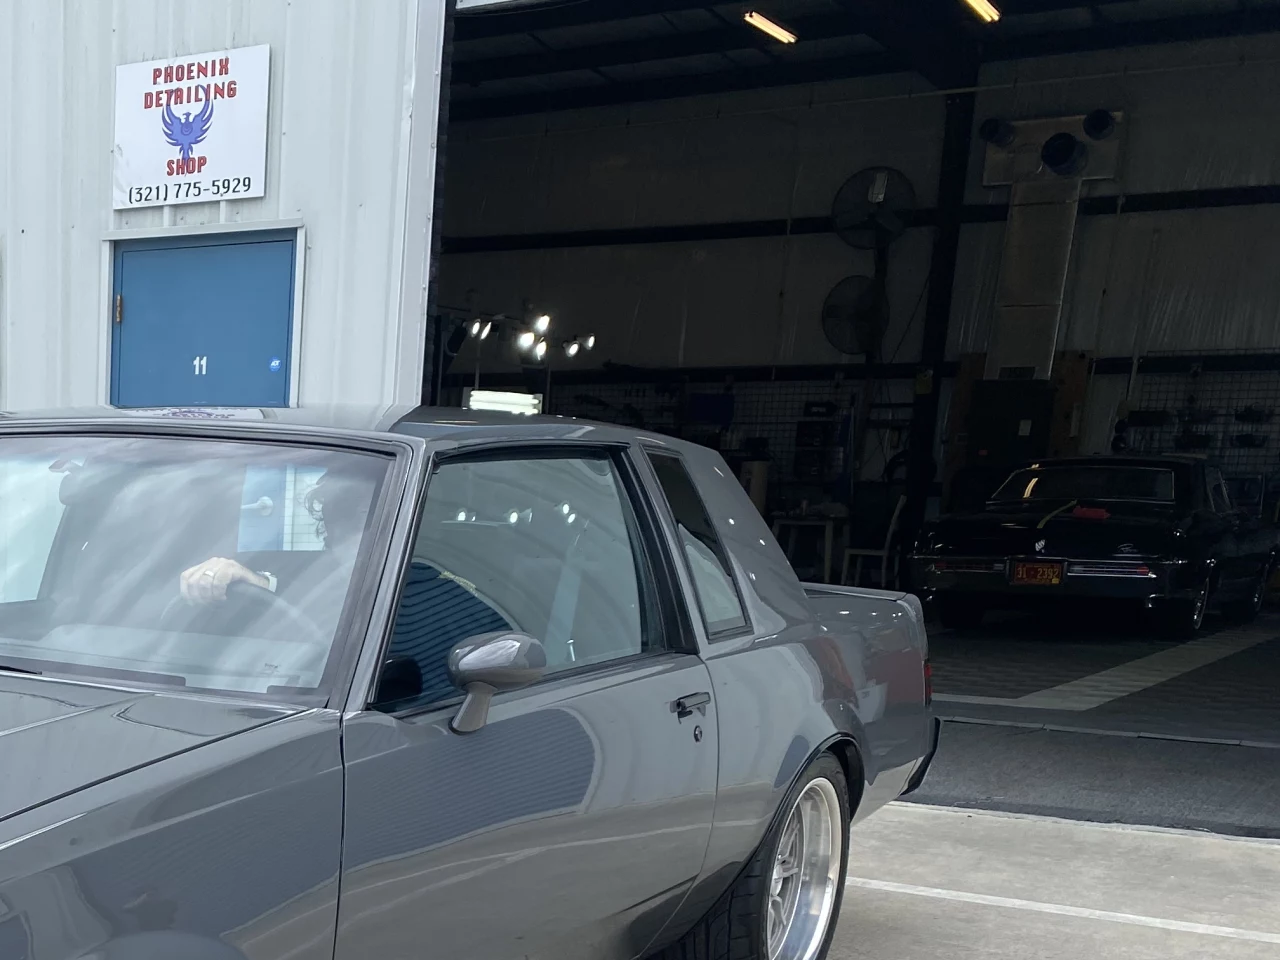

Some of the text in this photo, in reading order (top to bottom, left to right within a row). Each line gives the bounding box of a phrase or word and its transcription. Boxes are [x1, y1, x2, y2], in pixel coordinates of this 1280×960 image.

[152, 57, 230, 85] PHOENIX
[143, 80, 237, 109] DETAILING
[166, 156, 207, 176] SHOP
[128, 176, 251, 204] (321) 775-5929
[193, 356, 207, 375] 11
